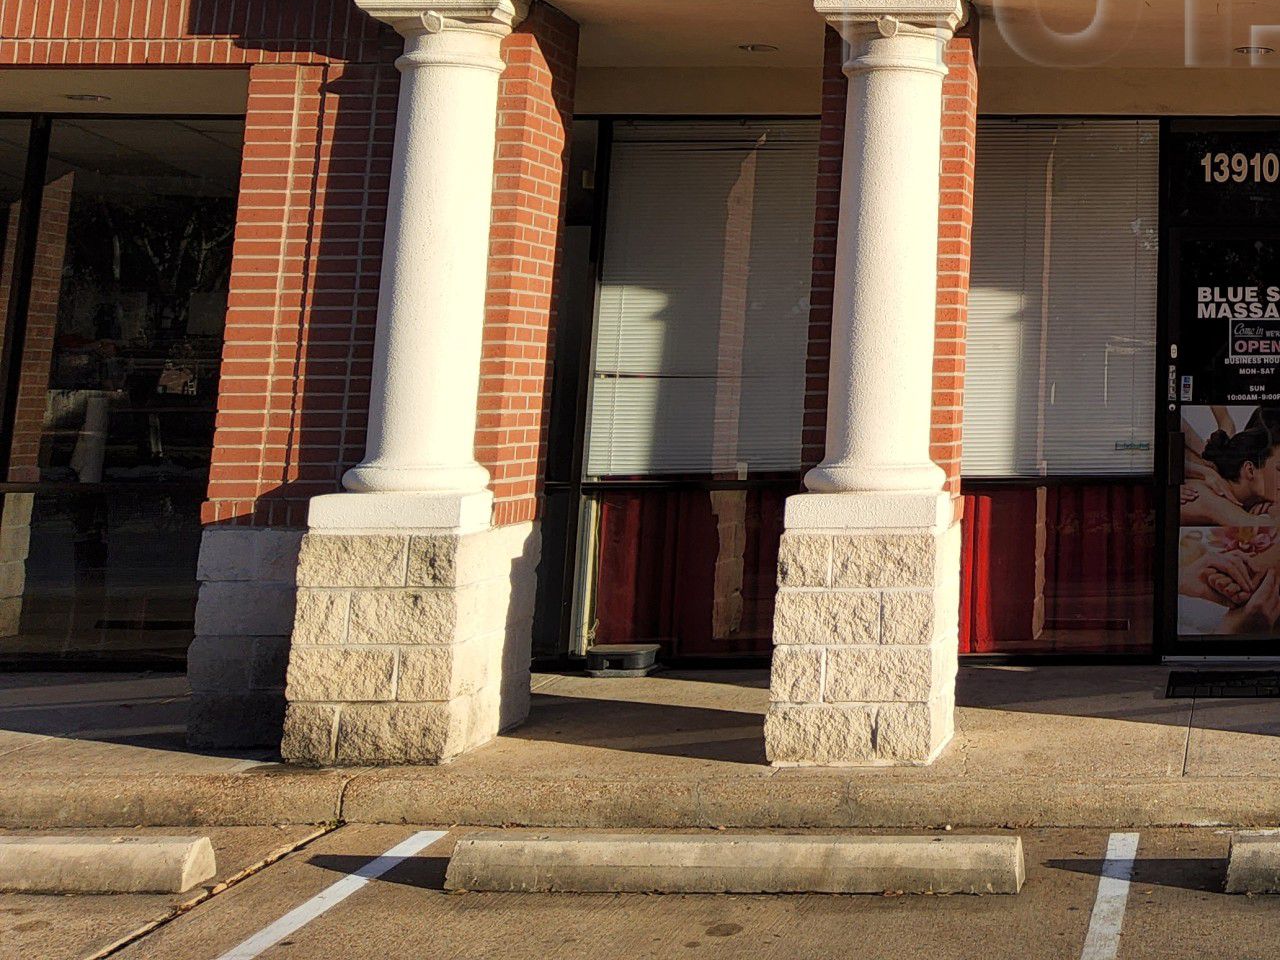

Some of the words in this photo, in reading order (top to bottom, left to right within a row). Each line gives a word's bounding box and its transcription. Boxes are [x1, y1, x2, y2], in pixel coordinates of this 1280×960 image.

[1197, 286, 1259, 302] BLUE
[1224, 356, 1262, 365] BUSINESS
[1239, 367, 1275, 375] MON-SAT
[1249, 384, 1265, 392] SUN
